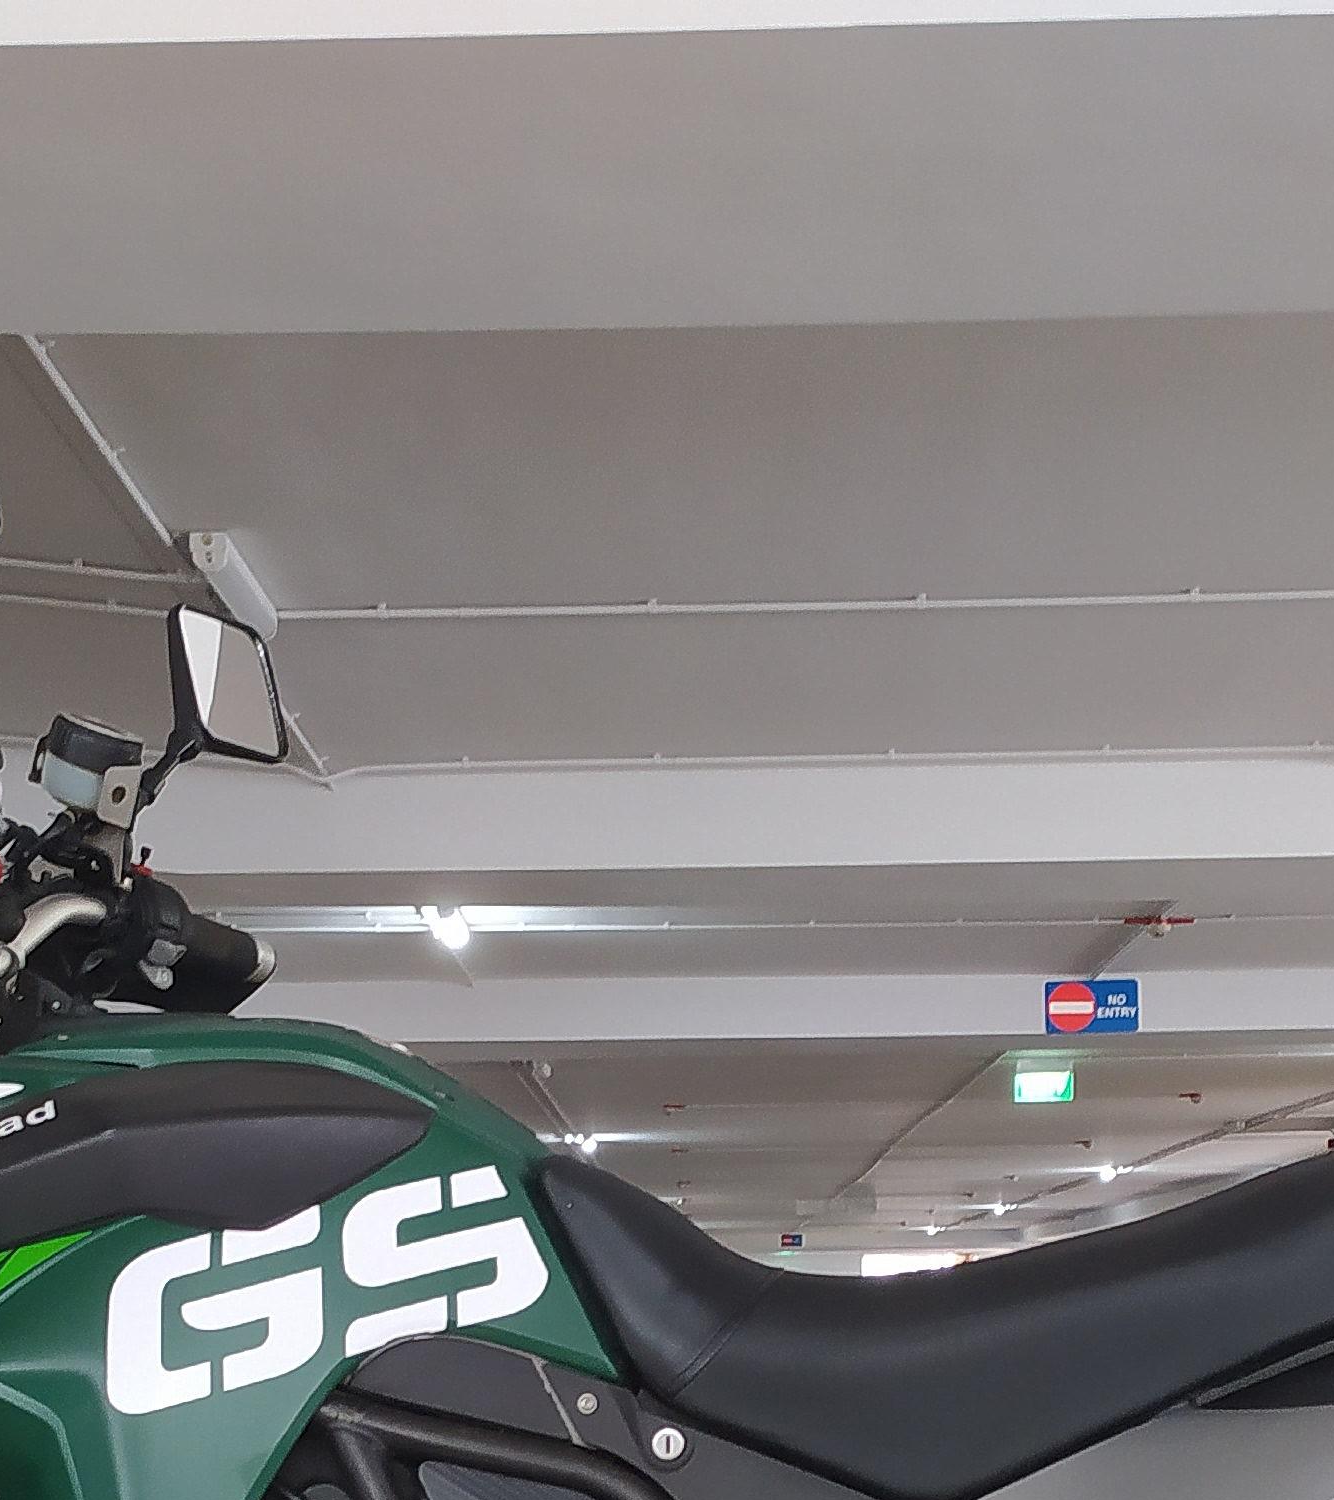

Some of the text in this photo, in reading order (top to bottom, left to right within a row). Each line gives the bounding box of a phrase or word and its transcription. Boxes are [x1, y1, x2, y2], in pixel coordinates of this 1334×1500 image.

[1107, 993, 1127, 1006] NO
[1096, 1006, 1137, 1019] ENTRY
[104, 1164, 550, 1417] GS
